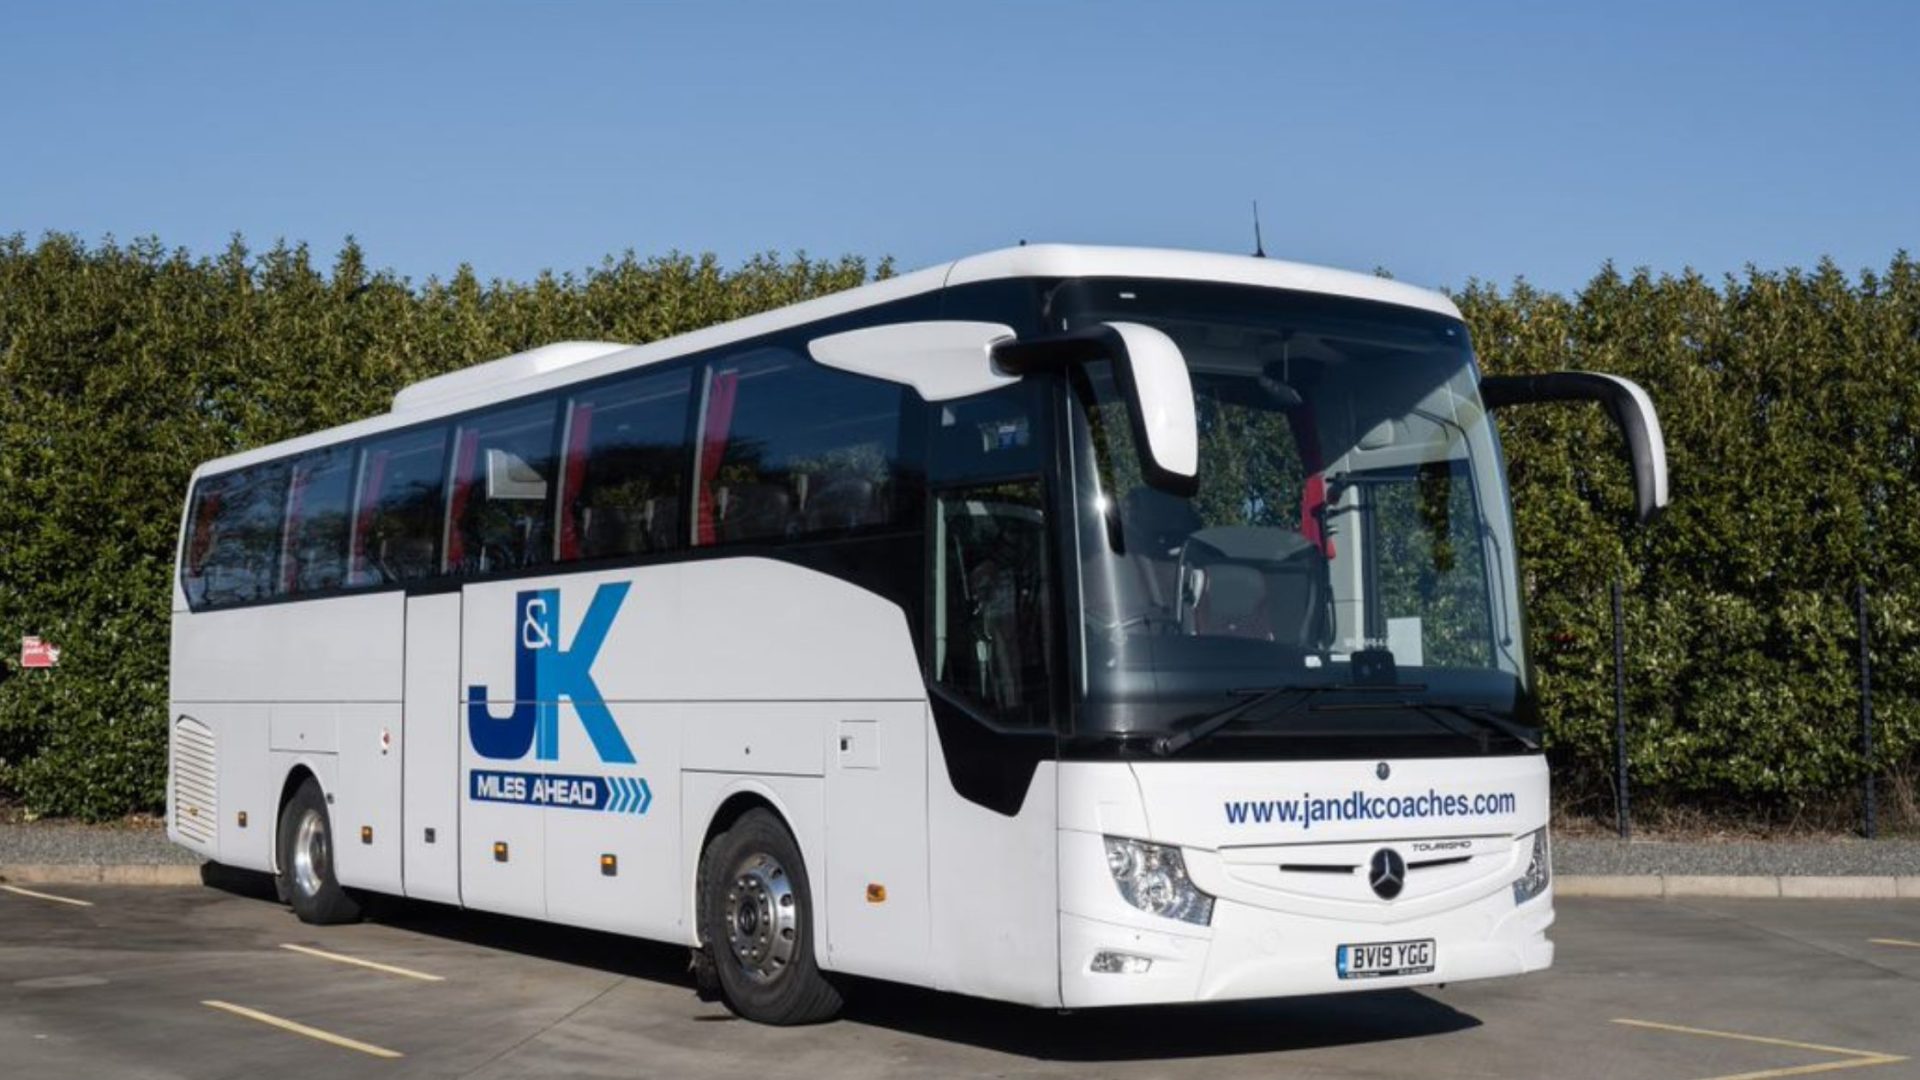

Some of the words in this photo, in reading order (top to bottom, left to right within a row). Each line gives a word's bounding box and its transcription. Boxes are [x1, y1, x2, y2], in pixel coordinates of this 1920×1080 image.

[477, 775, 526, 800] MILES
[531, 778, 597, 805] AHEAD
[1224, 788, 1516, 829] www.jandkcoaches.com
[1354, 947, 1392, 969] BV19
[1398, 943, 1429, 966] YGG
